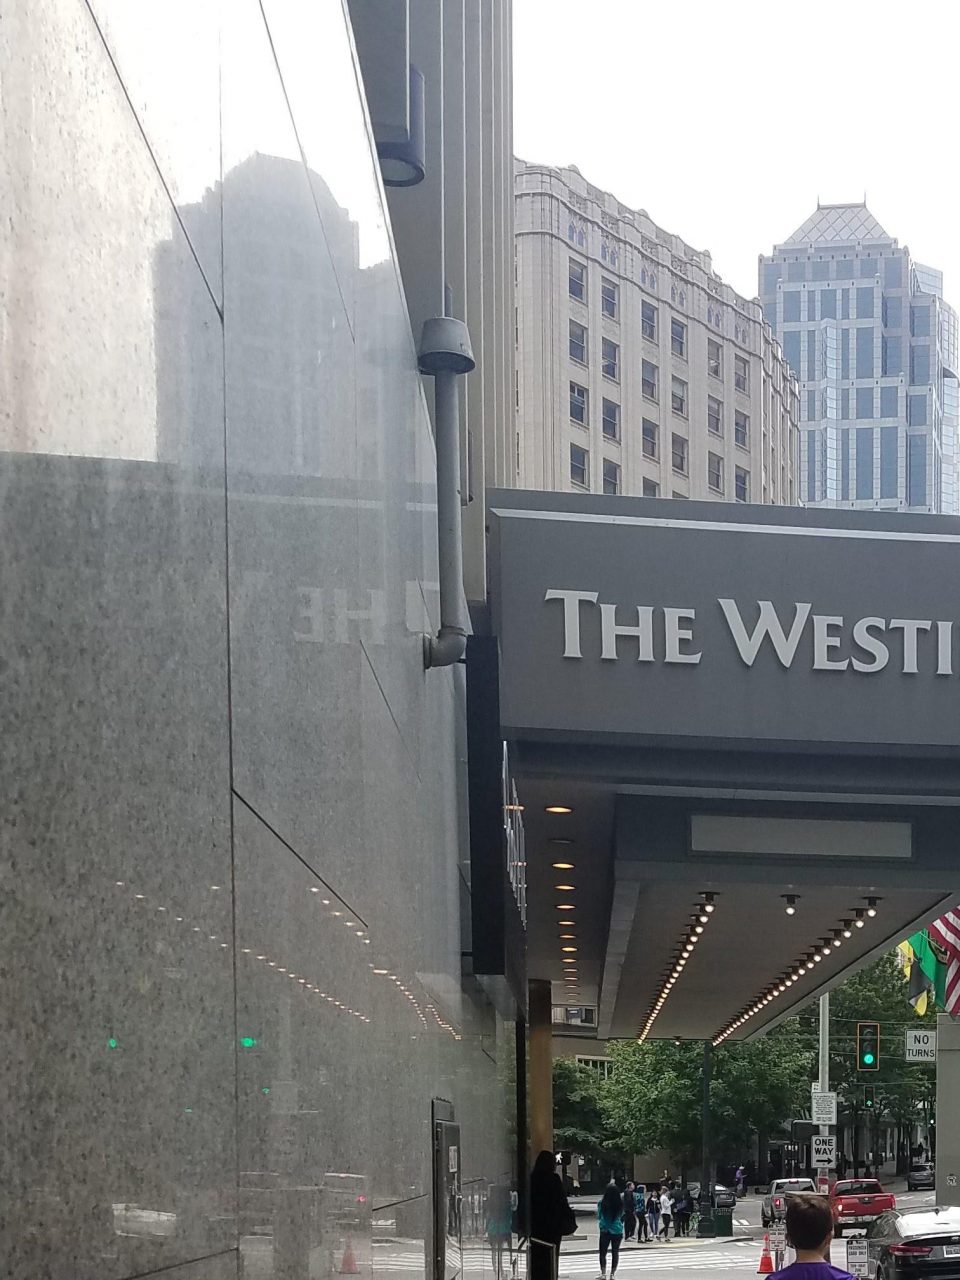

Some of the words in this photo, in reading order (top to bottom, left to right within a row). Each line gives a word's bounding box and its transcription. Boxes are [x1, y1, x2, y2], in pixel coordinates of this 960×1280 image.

[545, 589, 702, 665] THE
[913, 1034, 930, 1045] NO
[907, 1048, 935, 1058] TURNS
[814, 1138, 834, 1147] ONE
[814, 1147, 834, 1156] WAY
